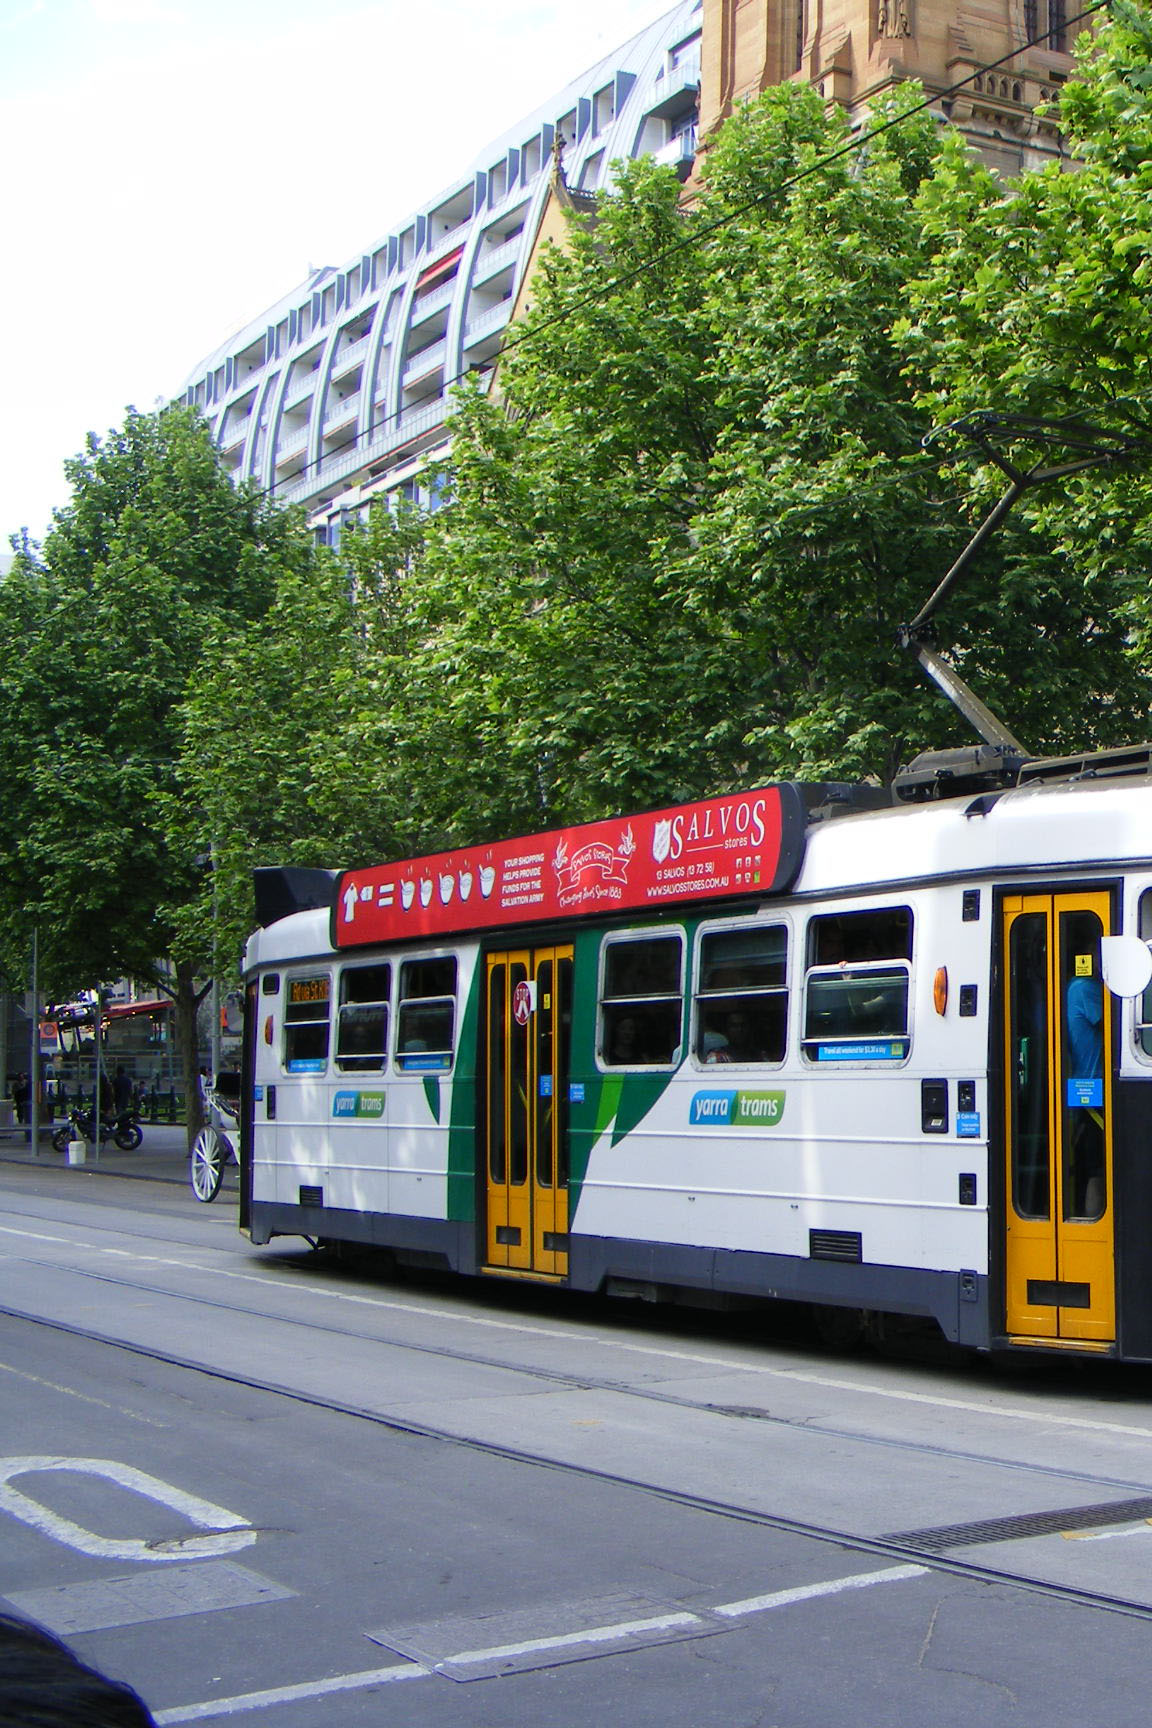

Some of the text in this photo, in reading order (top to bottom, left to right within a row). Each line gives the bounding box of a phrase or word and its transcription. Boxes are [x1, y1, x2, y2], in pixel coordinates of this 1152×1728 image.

[670, 799, 766, 859] SALVOS
[724, 837, 748, 849] stores
[518, 852, 545, 866] SHOPPING
[519, 866, 542, 879] PROVIDE
[663, 866, 685, 879] SALVOS
[696, 863, 704, 874] 72
[501, 879, 542, 894] FUNDS FOR THE
[646, 875, 729, 897] WWW.SALVOSSTORES.COM.AU
[500, 892, 545, 908] SALVATION ARMY
[336, 1096, 382, 1114] yarra trams
[695, 1095, 778, 1120] yarra trams
